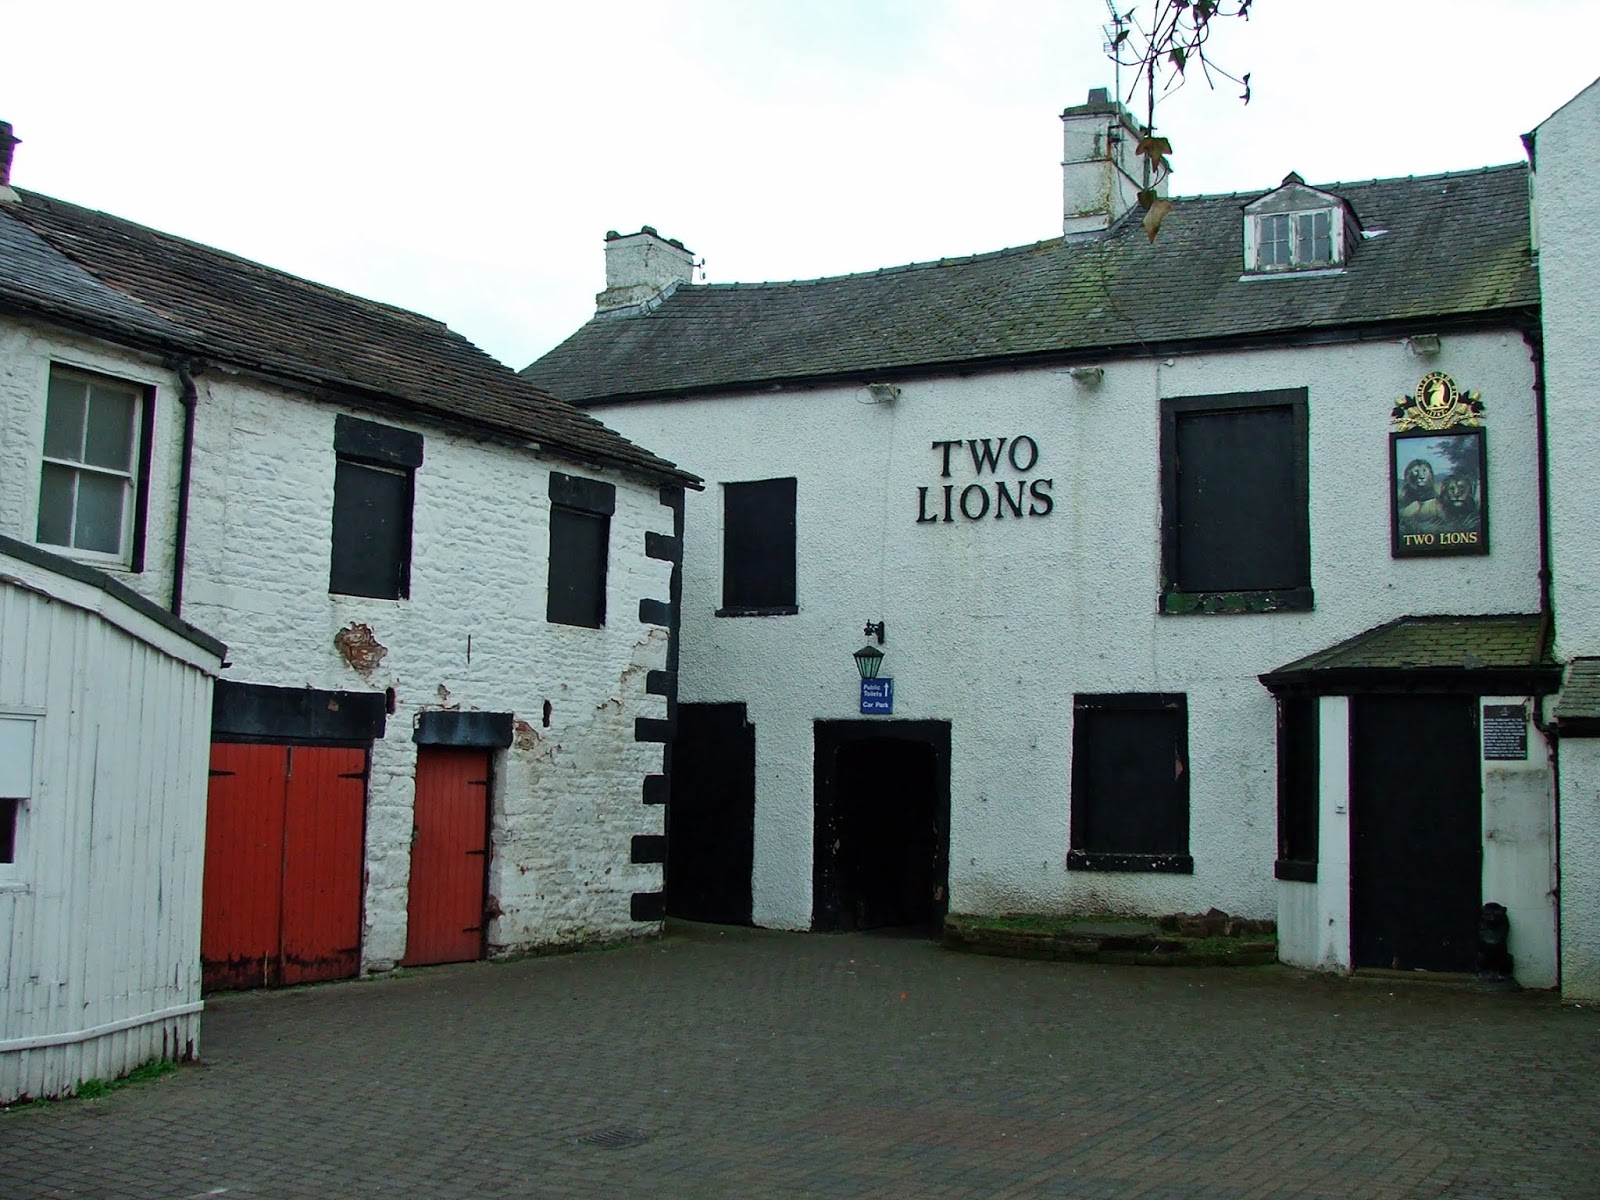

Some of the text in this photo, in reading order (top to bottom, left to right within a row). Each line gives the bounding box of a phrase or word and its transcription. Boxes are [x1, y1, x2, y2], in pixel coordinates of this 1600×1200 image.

[931, 435, 1039, 477] TWO
[916, 478, 1054, 523] LIONS
[1403, 531, 1478, 546] TWO LIONS
